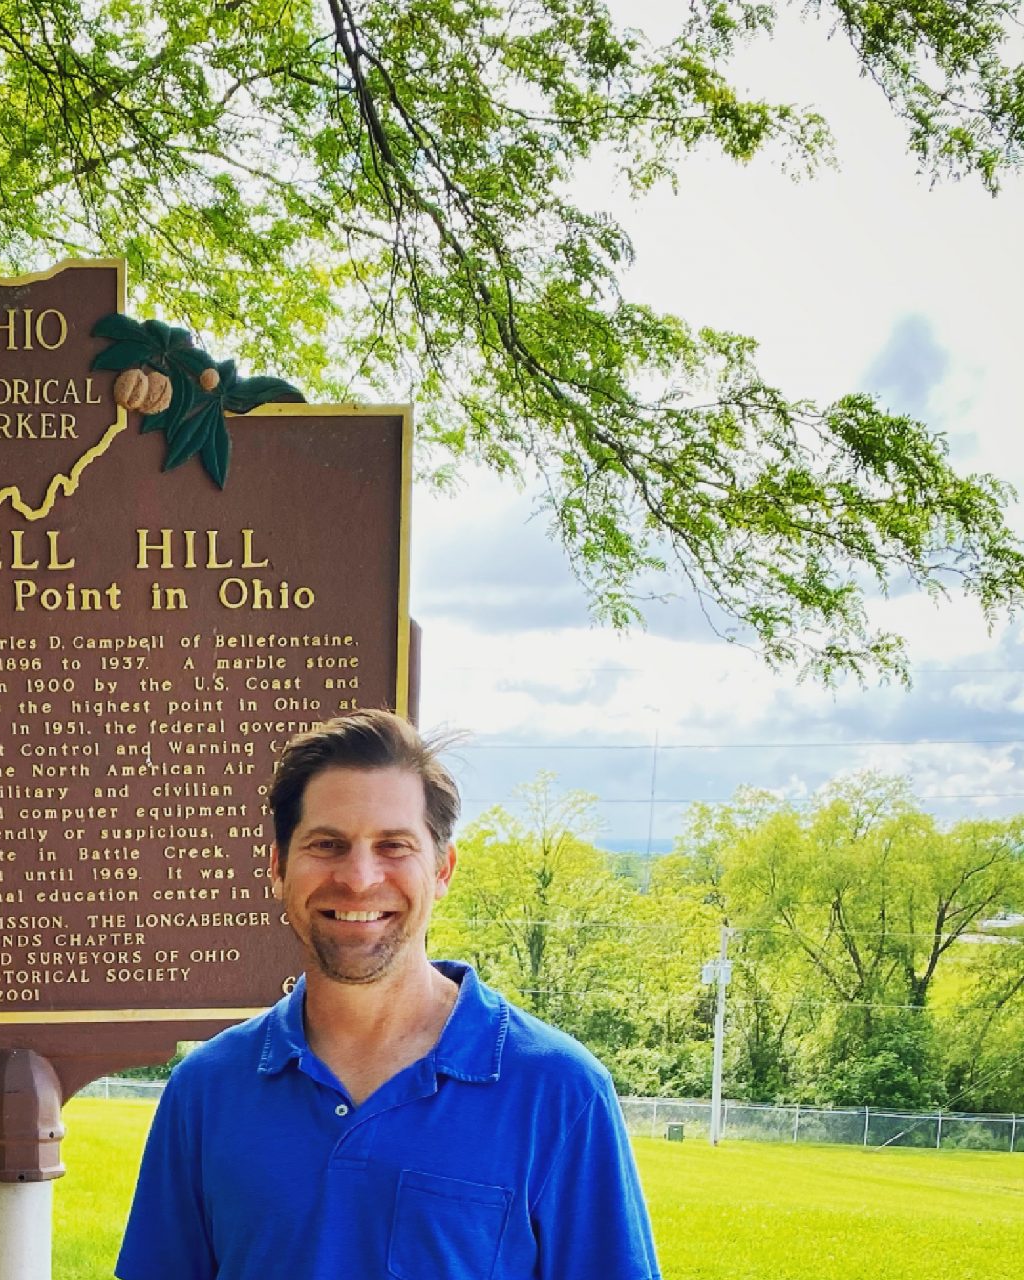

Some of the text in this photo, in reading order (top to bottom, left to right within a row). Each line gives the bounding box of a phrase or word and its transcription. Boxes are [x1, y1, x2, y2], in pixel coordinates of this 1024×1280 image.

[136, 529, 269, 569] HILL
[13, 579, 122, 612] Point
[151, 582, 189, 610] in
[219, 577, 315, 609] Ohio
[72, 635, 164, 653] Campbell
[180, 634, 201, 649] of
[61, 657, 82, 670] to
[101, 656, 149, 670] 1937.
[183, 656, 195, 670] A
[215, 655, 287, 669] marble
[306, 655, 359, 669] stone
[27, 677, 75, 693] 1900
[94, 677, 118, 694] by
[139, 677, 172, 692] the
[194, 676, 229, 692] U.S.
[245, 676, 301, 691] Coast
[325, 676, 359, 689] and
[18, 700, 52, 714] the
[71, 700, 151, 717] highest
[168, 698, 224, 716] point
[239, 697, 258, 712] in
[274, 697, 321, 711] Ohio
[339, 698, 358, 711] at
[11, 722, 30, 735] In
[105, 720, 137, 735] the
[149, 718, 225, 735] federal
[239, 720, 324, 737] governm
[20, 742, 99, 757] Control
[116, 742, 151, 757] and
[168, 740, 254, 757] Warning
[32, 763, 90, 778] North
[106, 762, 206, 777] American
[223, 761, 255, 775] Air
[94, 783, 130, 798] and
[152, 782, 233, 797] civilian
[19, 806, 118, 822] computer
[136, 803, 247, 821] equipment
[63, 829, 86, 840] or
[229, 823, 264, 838] and
[38, 847, 57, 862] in
[78, 846, 140, 861] Battle
[25, 867, 74, 882] until
[92, 867, 143, 881] 1969.
[168, 866, 182, 880] It
[199, 867, 235, 880] was
[36, 887, 139, 903] education
[152, 887, 220, 901] center
[231, 886, 250, 900] in
[86, 914, 126, 929] THE
[136, 912, 271, 928] LONGABERGER
[55, 932, 146, 947] CHAPTER
[27, 950, 143, 965] SURVEYORS
[155, 950, 180, 963] OF
[189, 948, 241, 963] OHIO
[105, 967, 191, 983] SOCIETY
